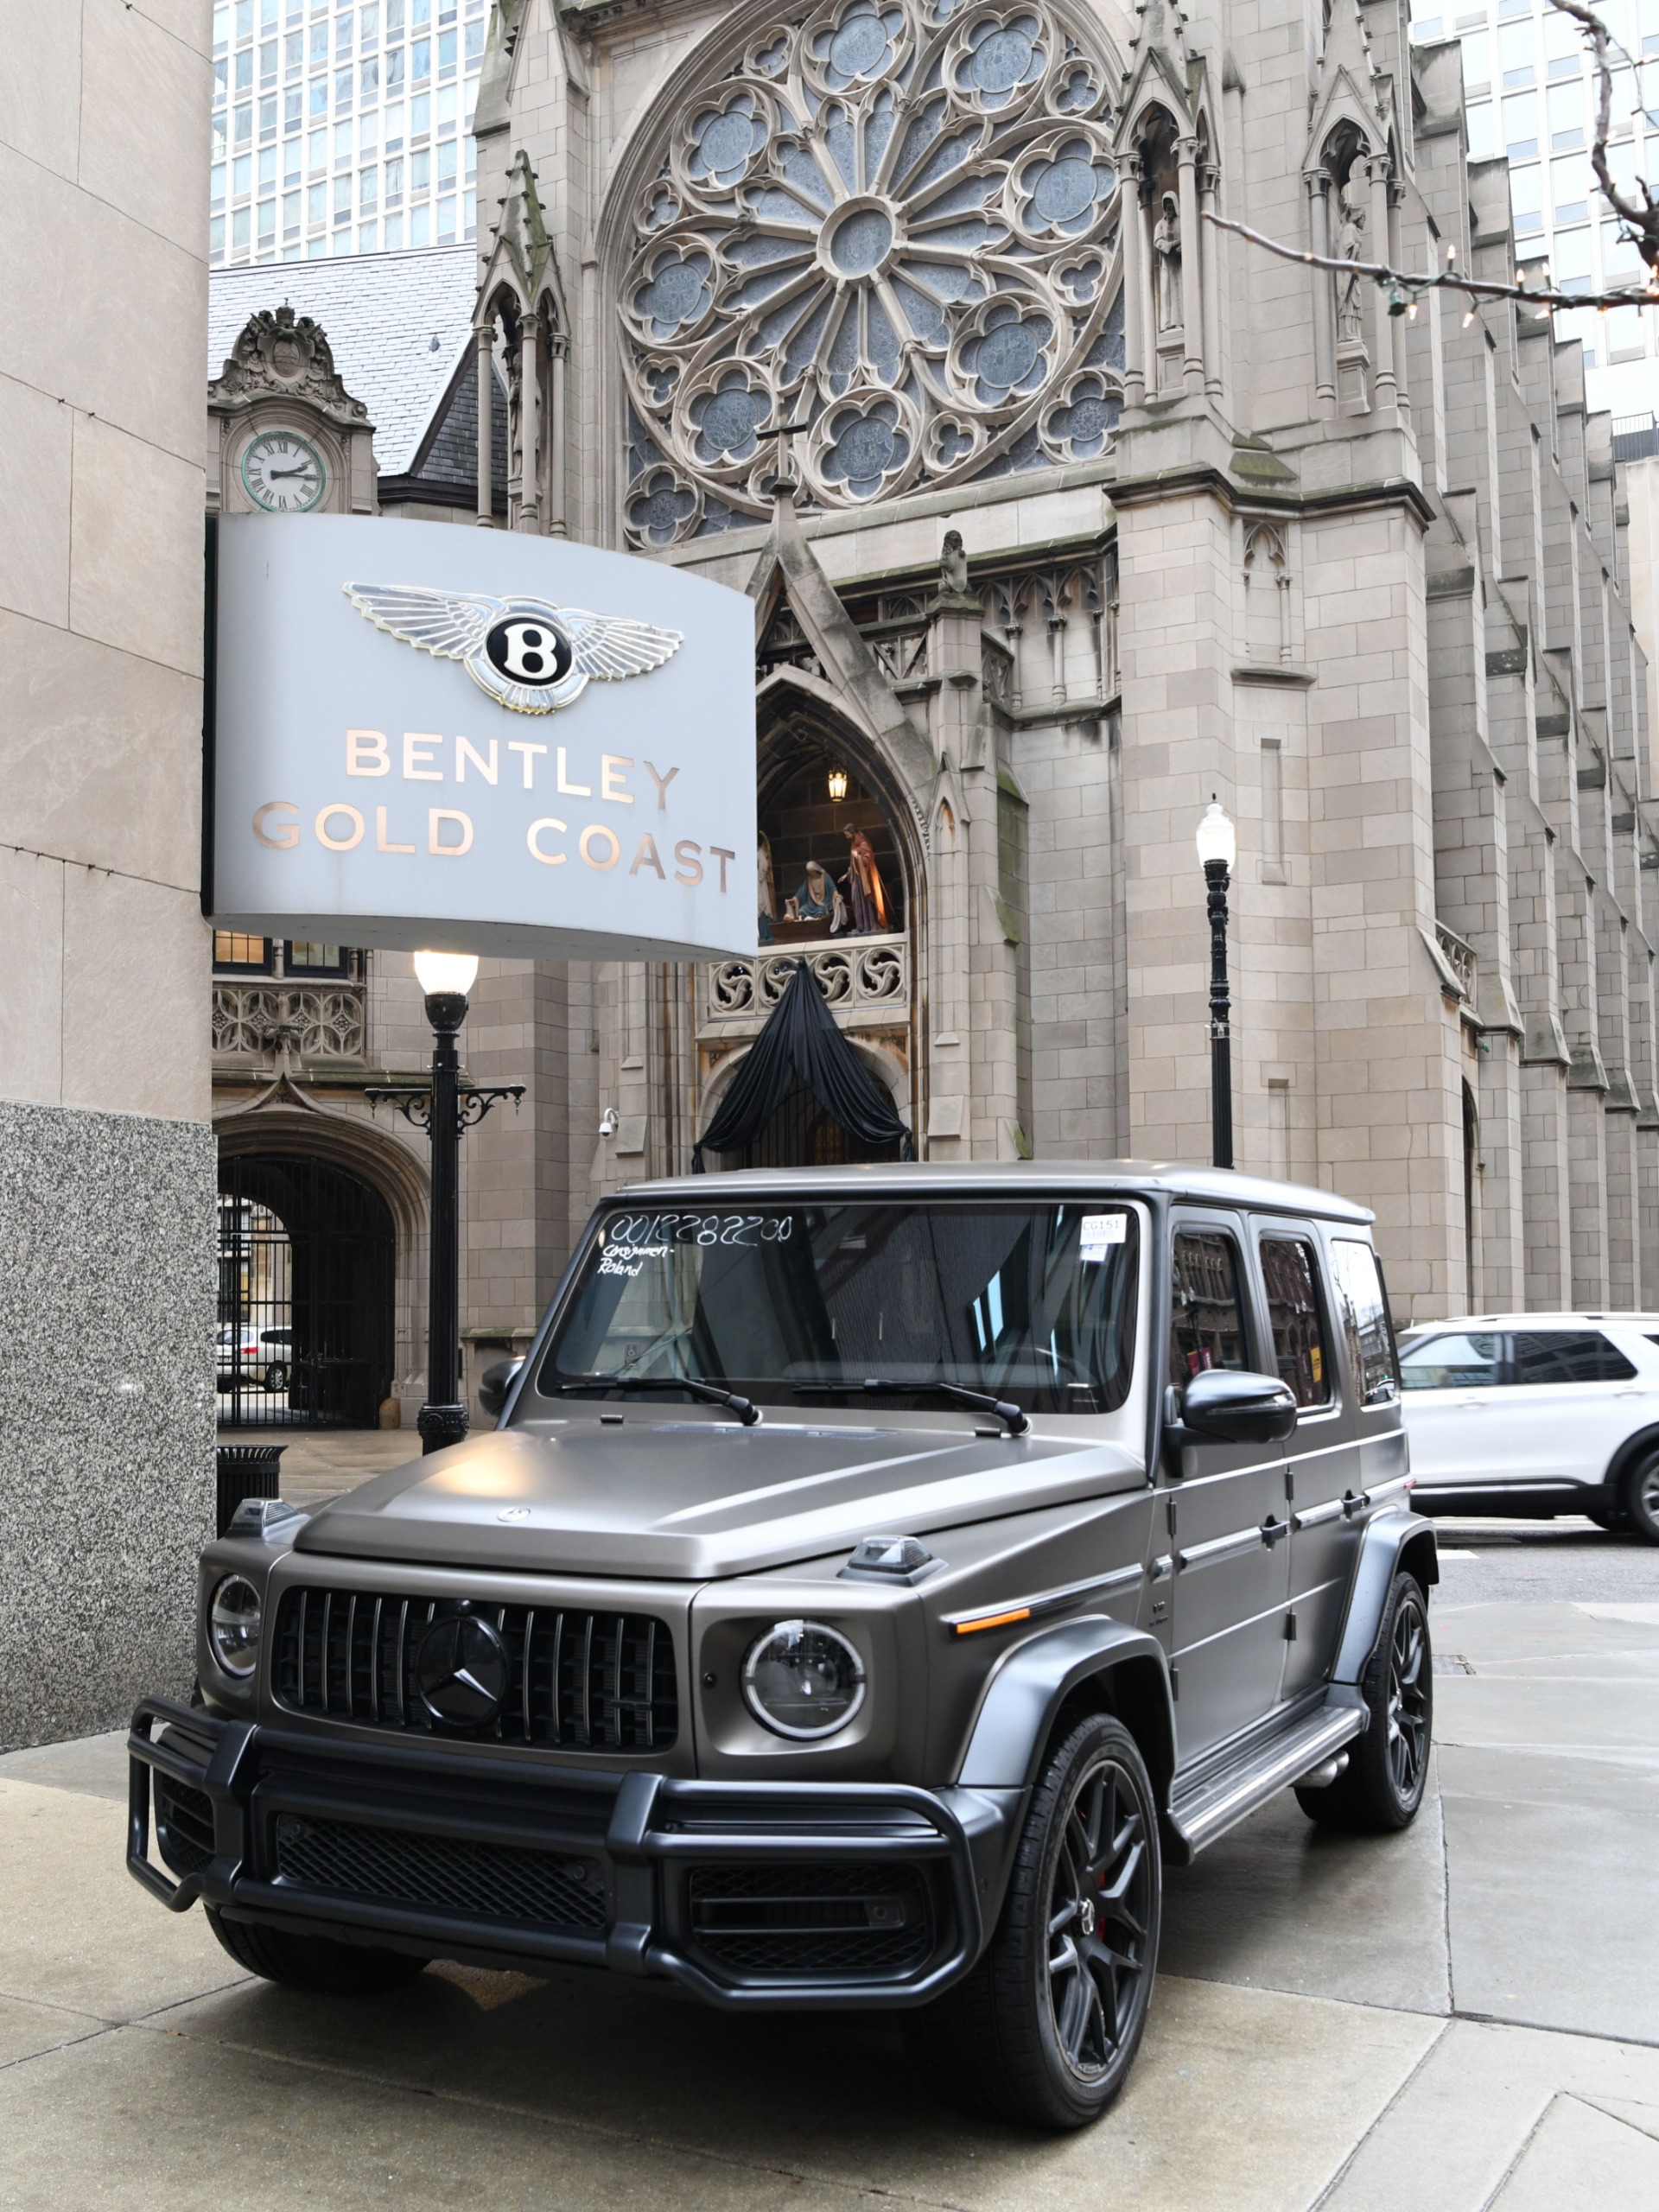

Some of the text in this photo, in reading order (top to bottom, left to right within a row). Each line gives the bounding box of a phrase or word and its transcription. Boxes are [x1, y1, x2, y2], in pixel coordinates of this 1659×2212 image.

[504, 622, 557, 679] B
[346, 728, 680, 810] BENTLEY
[252, 801, 736, 893] GOLD COAST
[1083, 1219, 1119, 1230] CG151
[597, 1257, 643, 1276] Roland
